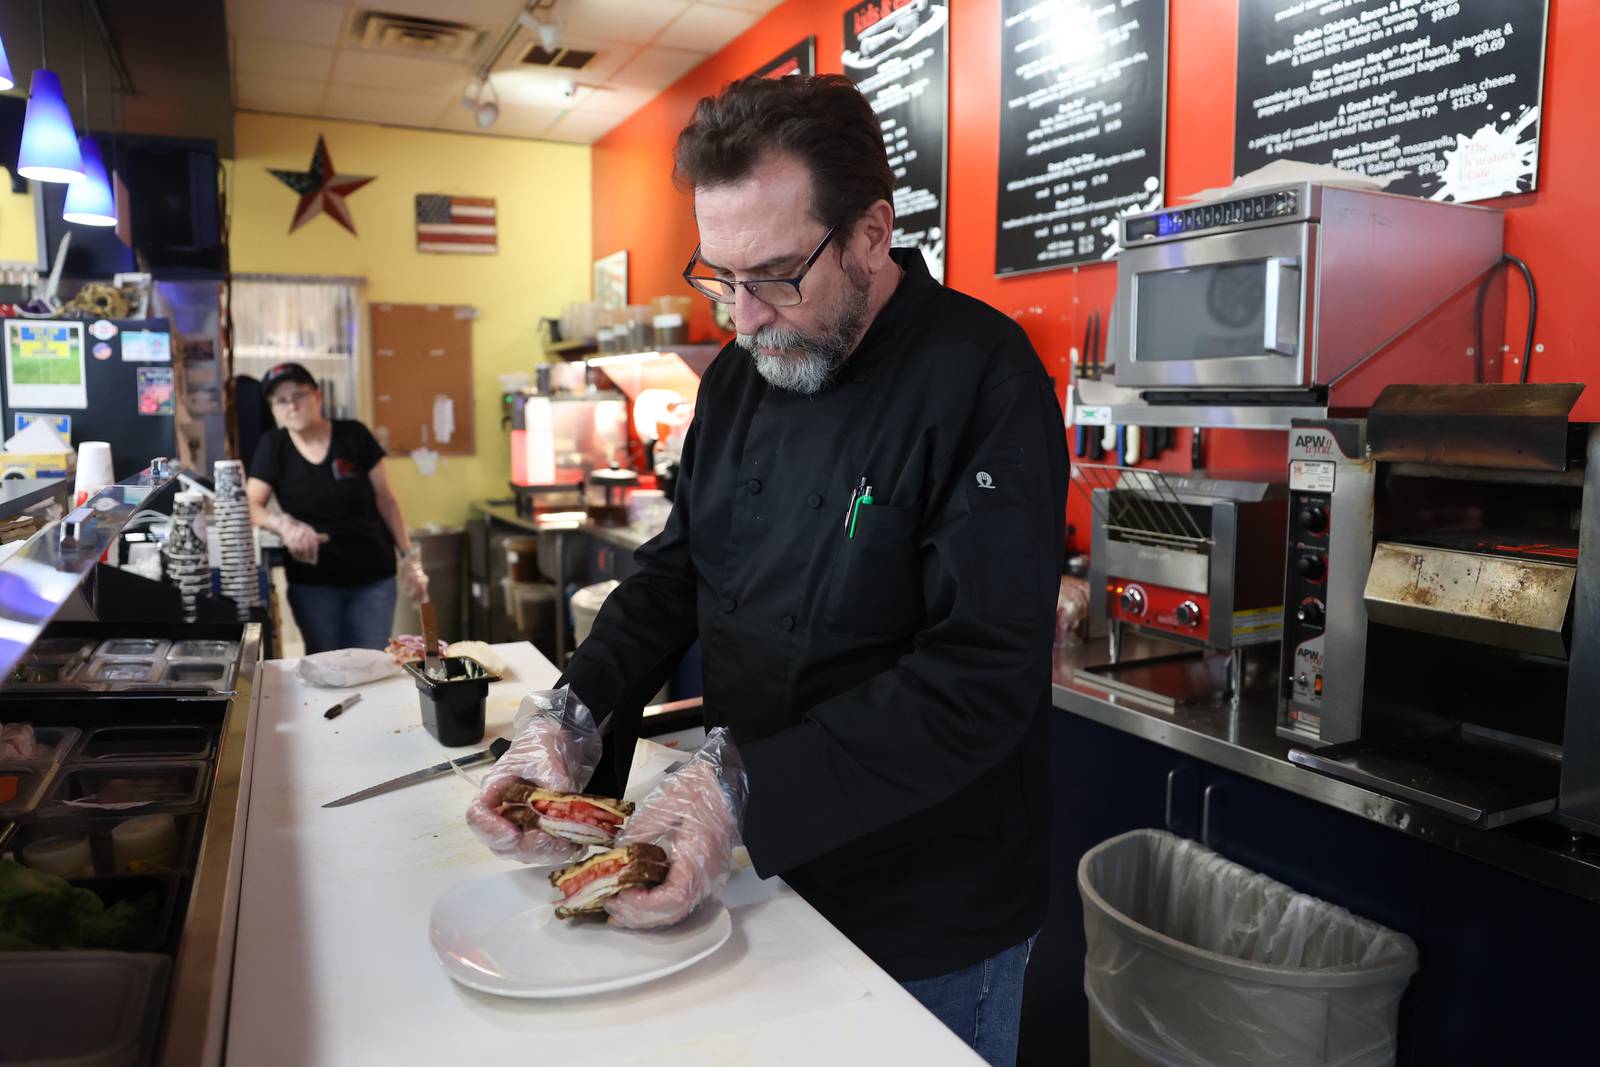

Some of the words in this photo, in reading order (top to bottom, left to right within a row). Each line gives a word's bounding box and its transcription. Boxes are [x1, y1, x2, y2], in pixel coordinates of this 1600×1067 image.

[1372, 30, 1384, 41] on
[1385, 27, 1393, 37] a
[1393, 19, 1418, 34] wrap
[1431, 2, 1460, 23] $9.69
[1371, 75, 1379, 86] a
[1379, 62, 1415, 86] pressed
[1416, 52, 1461, 72] baguette
[1474, 36, 1506, 58] $9.69
[1387, 49, 1424, 70] smoked
[1424, 44, 1451, 60] ham,
[1451, 28, 1502, 55] jalapeños
[1504, 22, 1514, 36] &
[1400, 34, 1430, 54] Panini
[1390, 100, 1409, 114] two
[1409, 95, 1437, 110] slices
[1437, 87, 1449, 102] of
[1449, 82, 1478, 99] swiss
[1479, 73, 1517, 91] cheese
[1421, 104, 1438, 119] rye
[1451, 90, 1488, 111] $15.99
[1418, 159, 1446, 176] $9.69
[1295, 435, 1326, 448] APW
